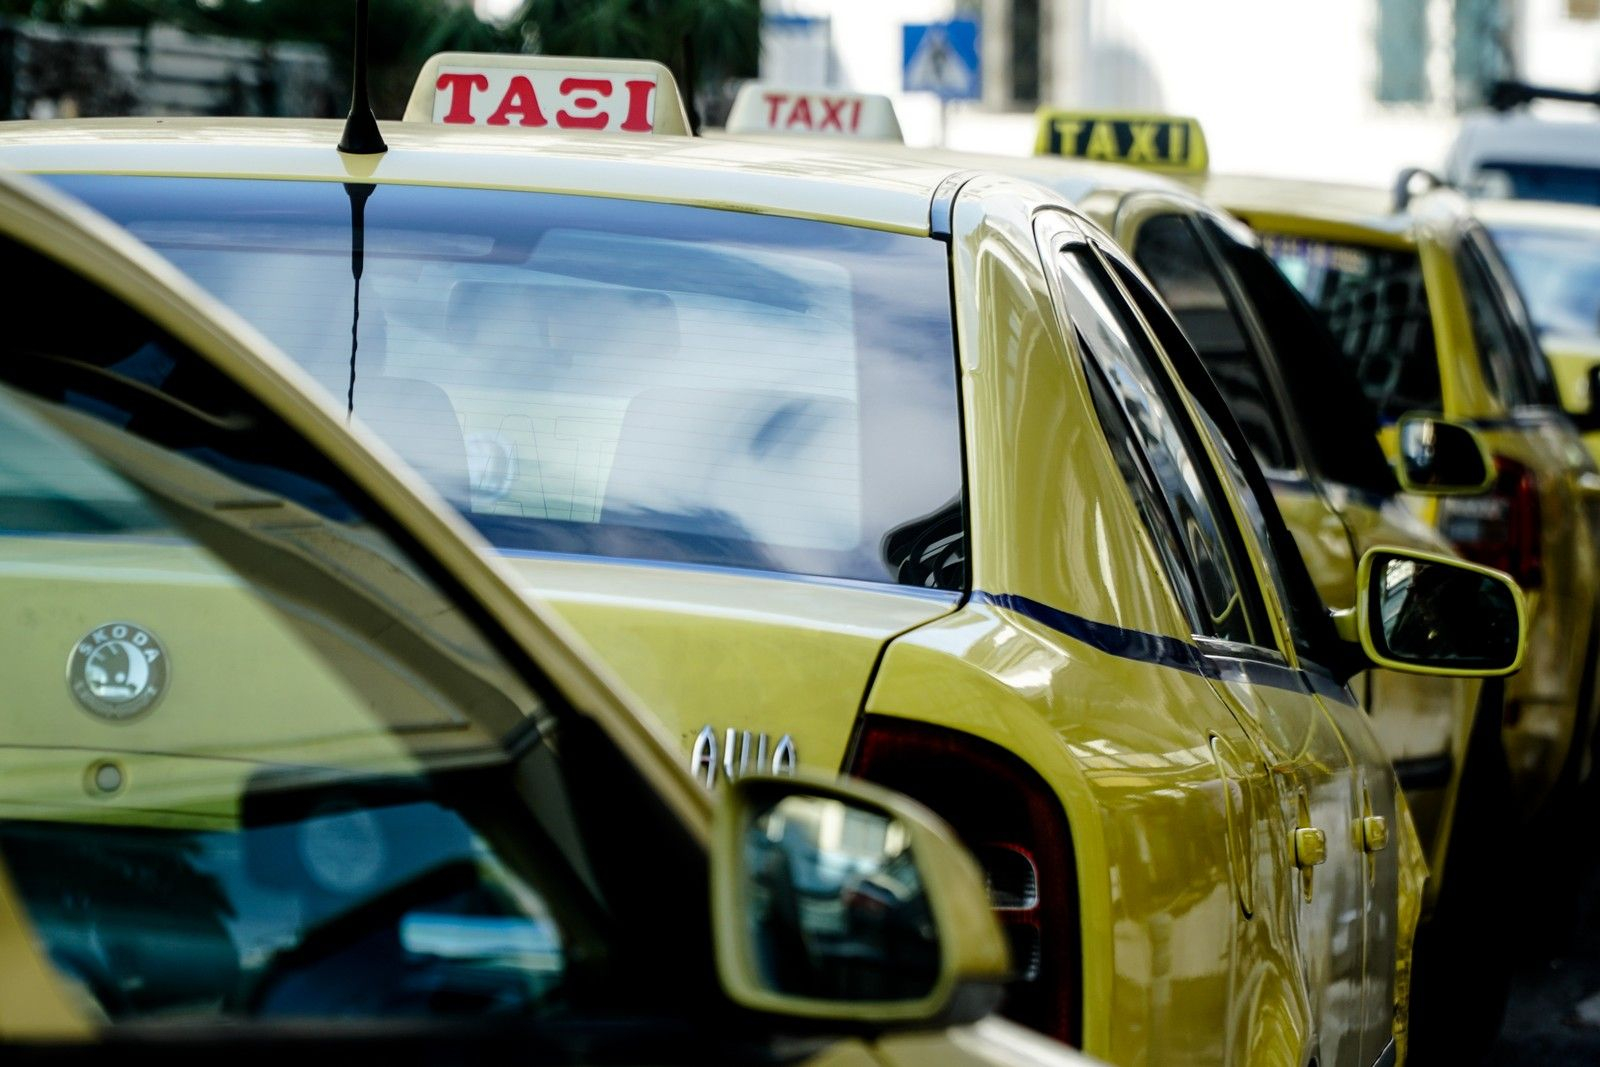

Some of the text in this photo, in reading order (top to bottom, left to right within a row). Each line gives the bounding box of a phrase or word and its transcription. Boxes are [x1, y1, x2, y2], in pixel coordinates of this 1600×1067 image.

[436, 73, 656, 132] ΤΑΞΙ
[763, 92, 863, 133] TAXI
[1053, 120, 1184, 164] TAXI
